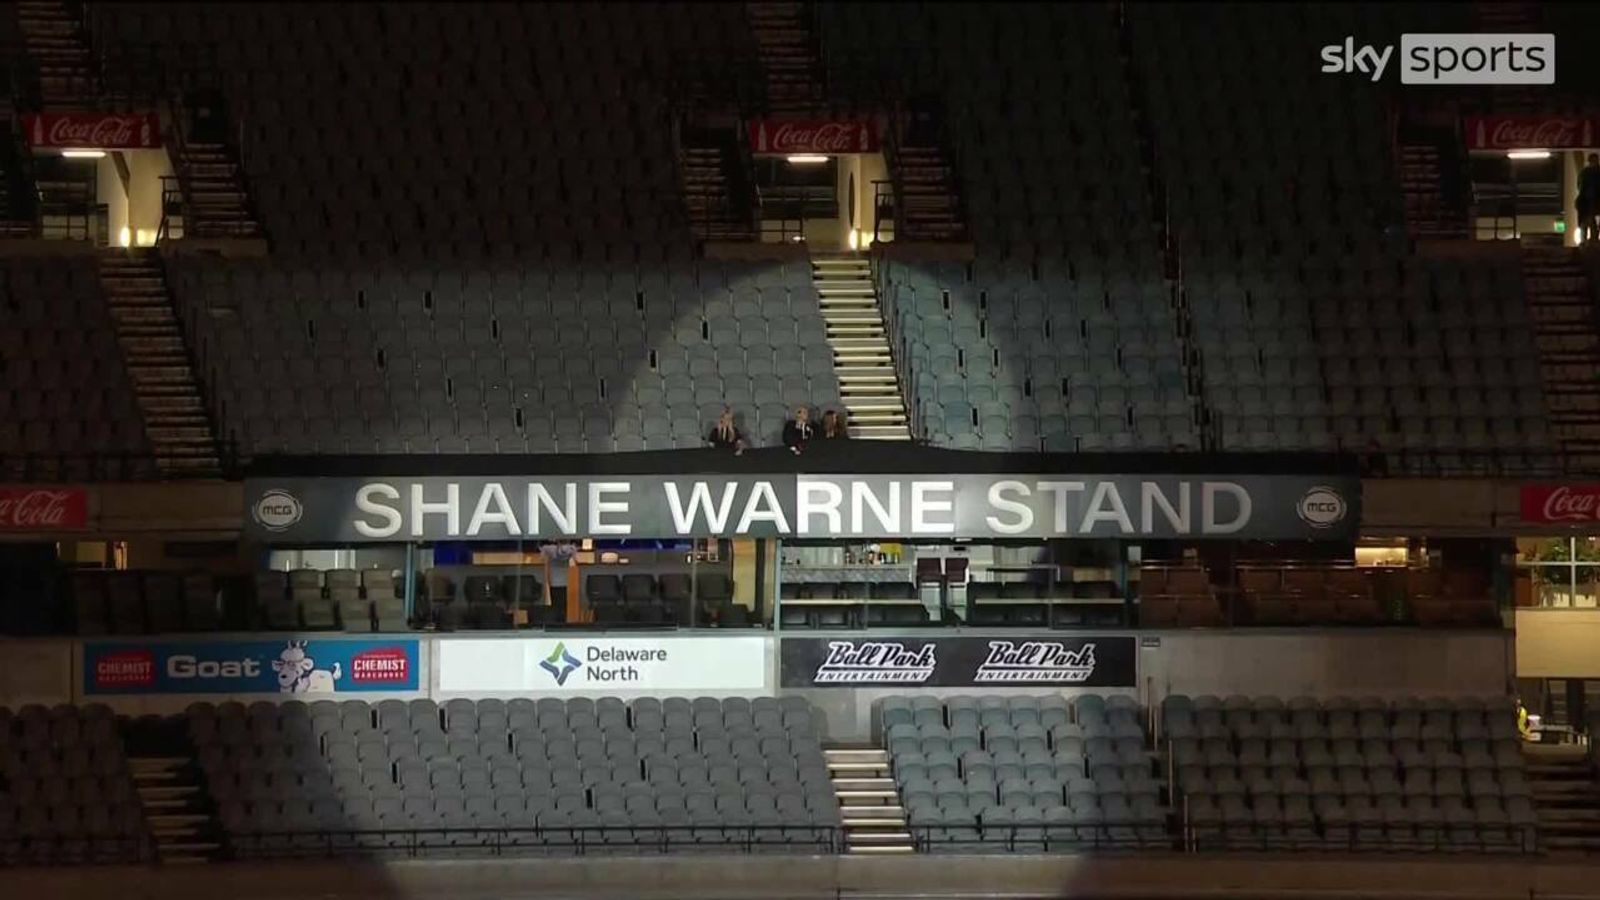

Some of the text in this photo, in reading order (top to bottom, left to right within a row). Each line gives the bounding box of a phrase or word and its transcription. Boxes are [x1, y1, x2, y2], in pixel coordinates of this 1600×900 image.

[262, 505, 292, 516] MCG
[353, 480, 1252, 538] SHANE WARNE STAND
[1307, 502, 1338, 513] MCG
[586, 646, 667, 661] Delaware
[828, 642, 935, 667] Ball Park
[989, 642, 1095, 667] Ball Park
[98, 661, 151, 674] CHEMIST
[166, 655, 261, 678] Goat
[353, 659, 407, 671] CHEMIST
[586, 666, 638, 681] North
[816, 671, 929, 681] ENTERTAINMENT
[976, 671, 1089, 681] ENTERTAINMENT
